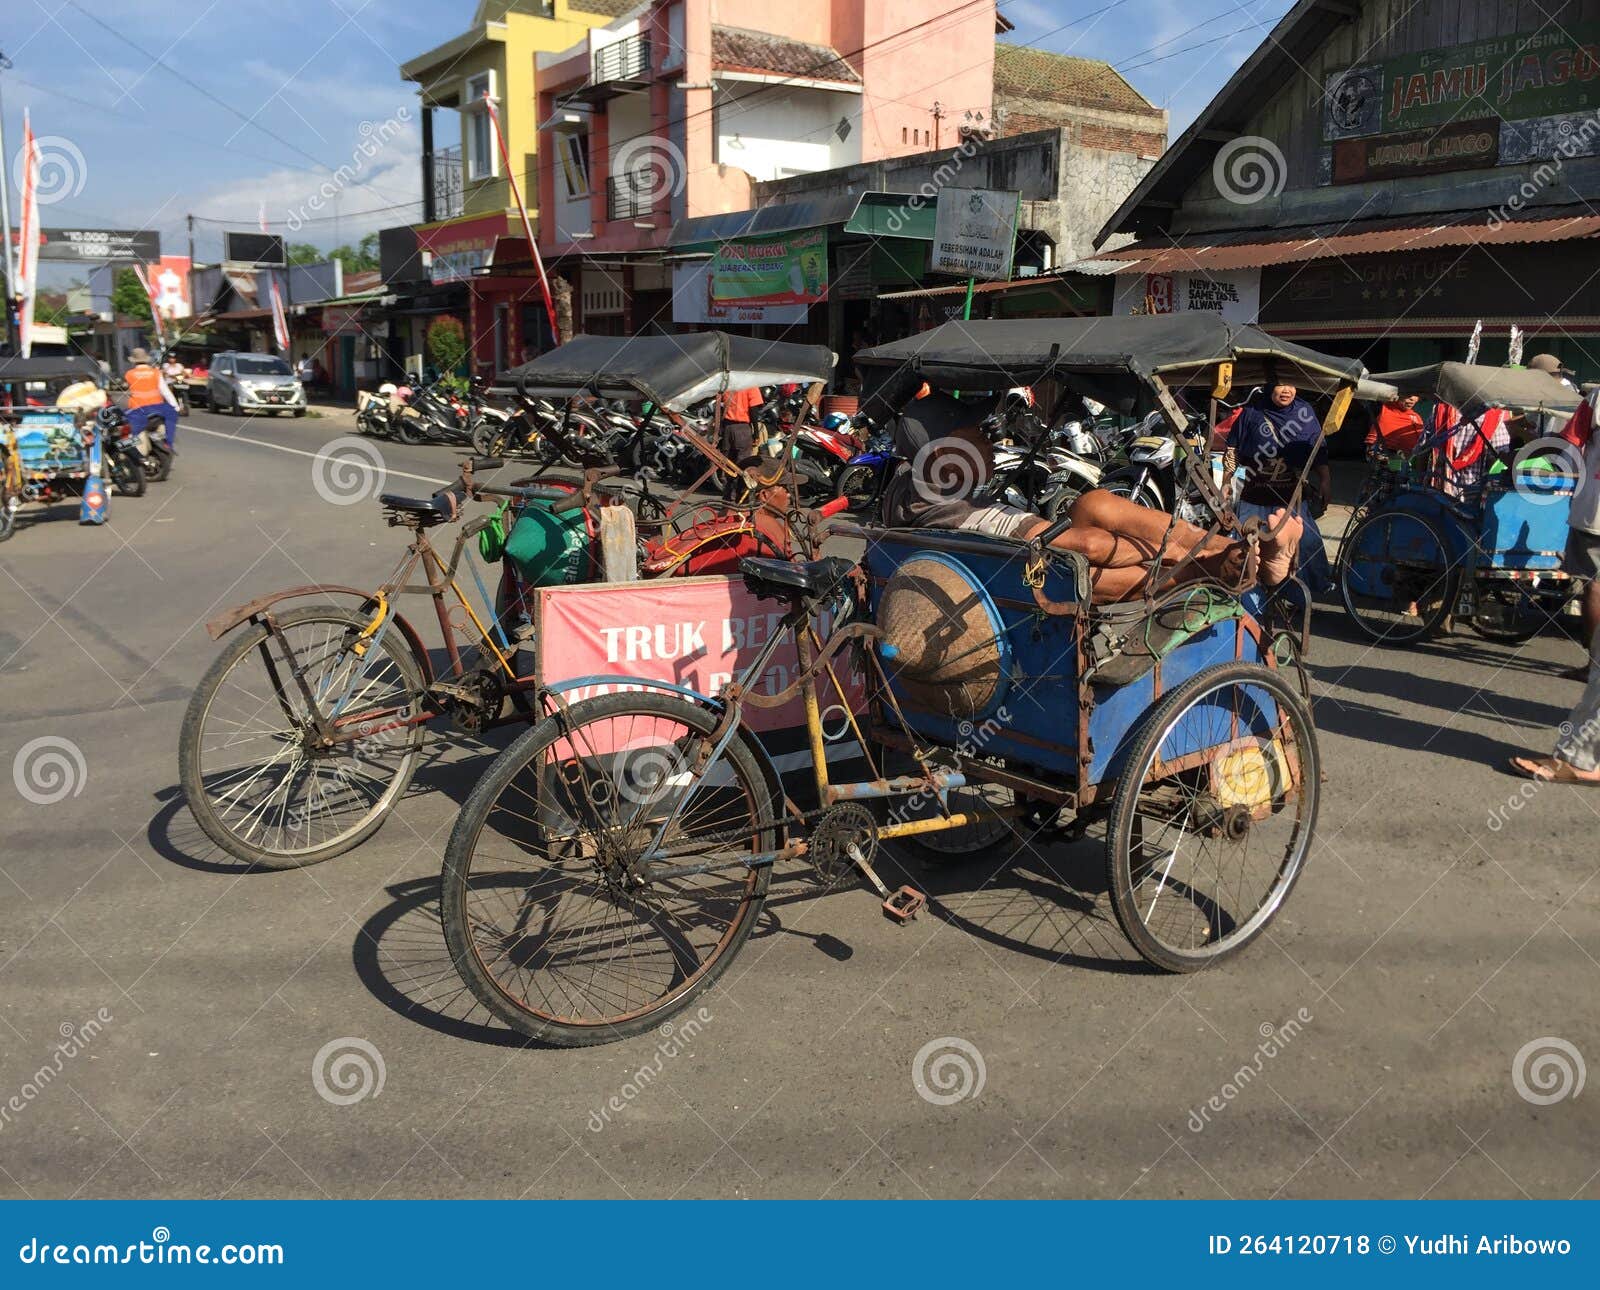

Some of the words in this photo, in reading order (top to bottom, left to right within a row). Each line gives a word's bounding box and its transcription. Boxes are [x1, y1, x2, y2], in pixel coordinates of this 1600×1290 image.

[1388, 63, 1488, 122] JAMU
[1497, 43, 1600, 105] JAGO
[1368, 142, 1430, 165] JAMU
[1434, 132, 1493, 158] JAGO
[940, 242, 978, 256] KEBERSIHAN
[978, 247, 1004, 260] ADALAH
[1343, 260, 1472, 284] SIGNATURE
[1188, 289, 1214, 301] SAME
[1189, 279, 1210, 290] NEW
[599, 620, 706, 663] TRUK
